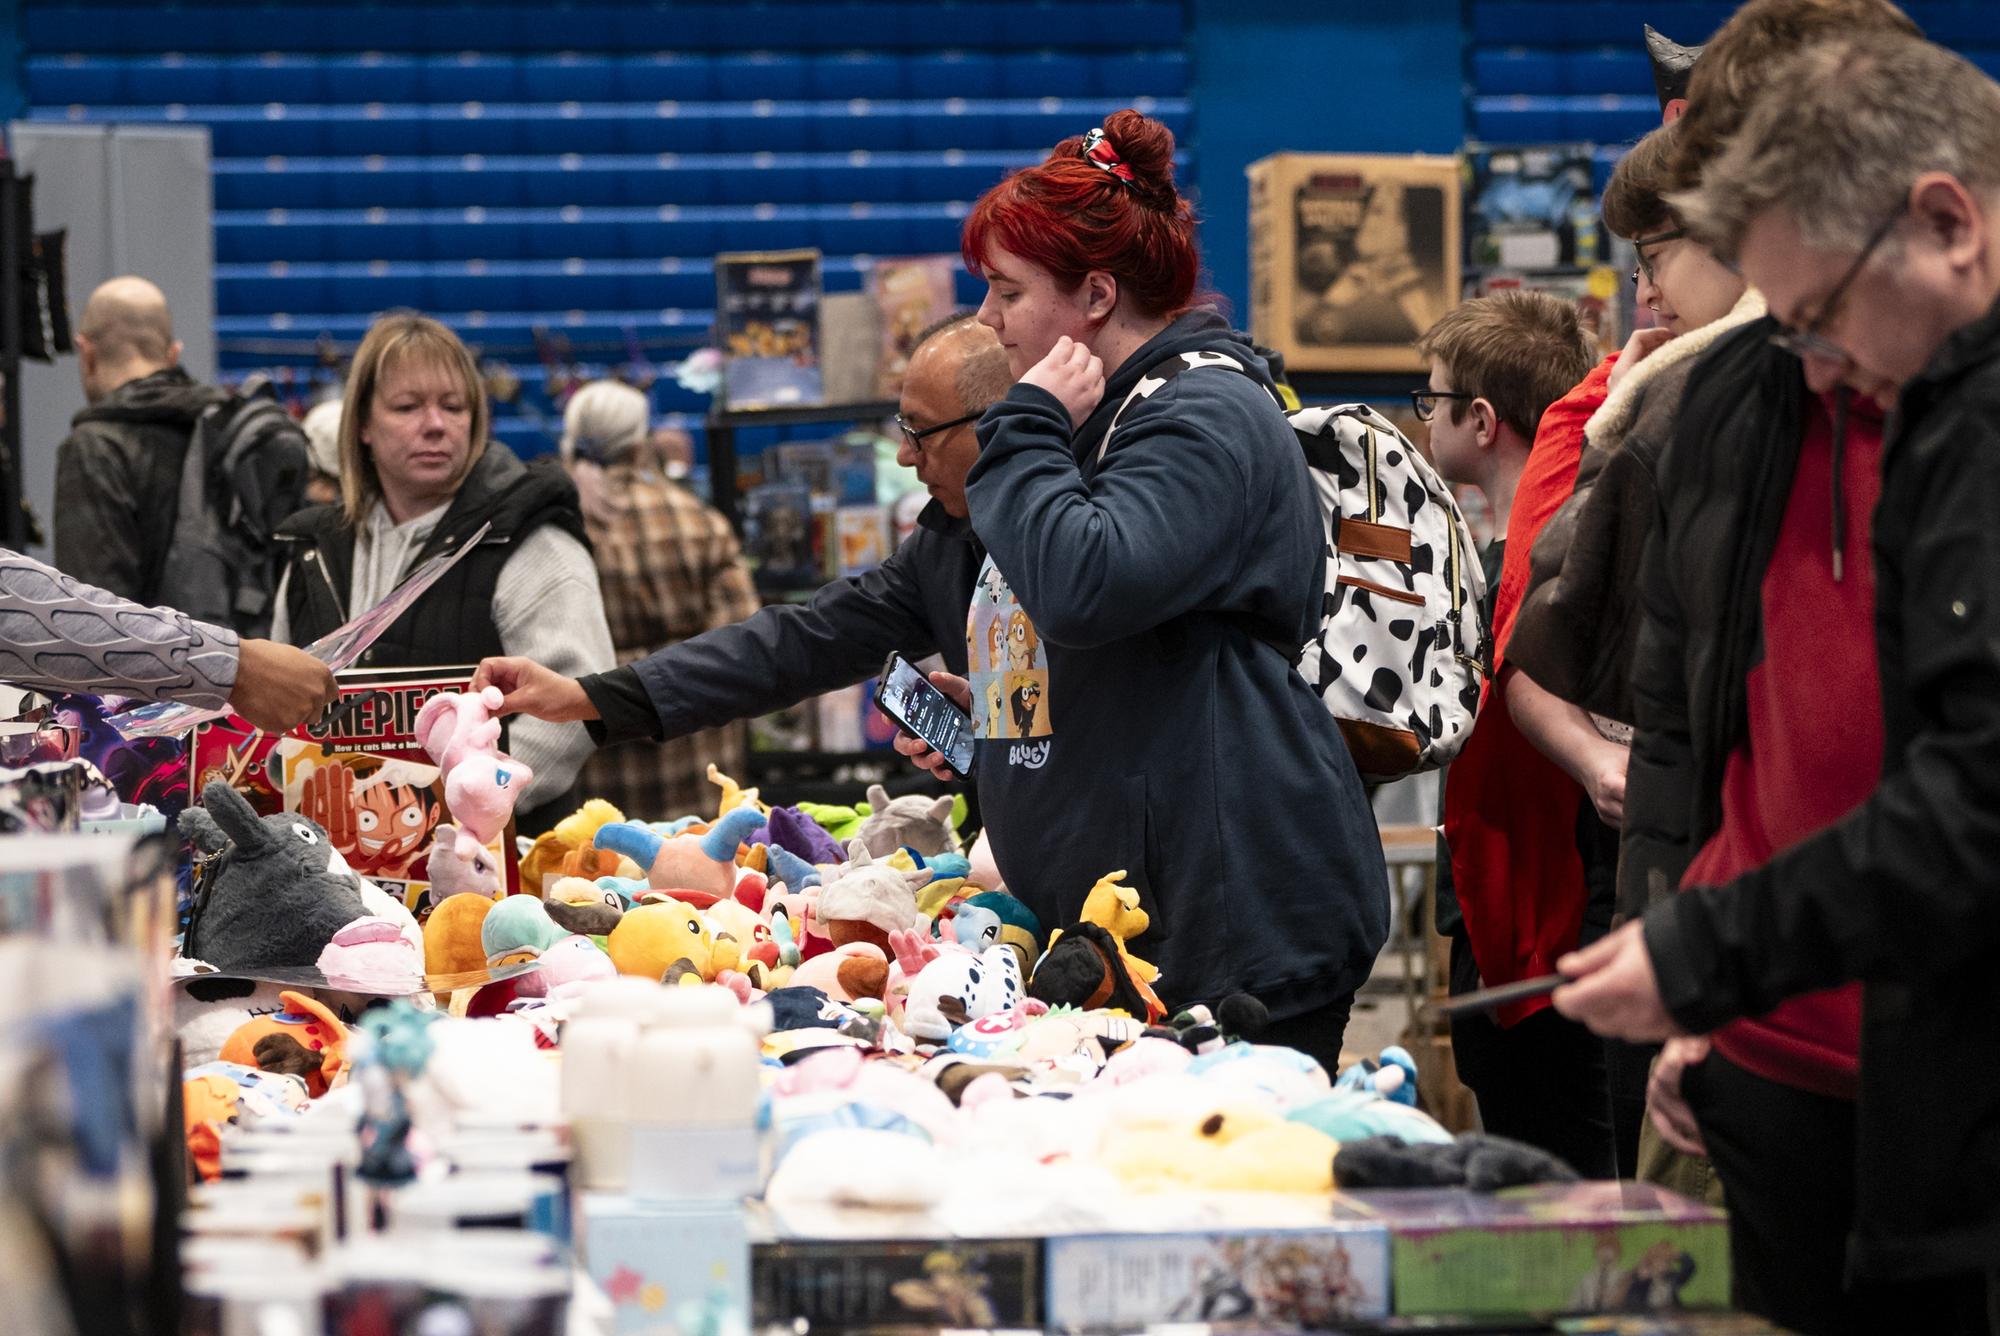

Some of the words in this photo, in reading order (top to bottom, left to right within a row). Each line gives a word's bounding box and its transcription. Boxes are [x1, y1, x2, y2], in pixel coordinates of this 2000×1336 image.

[363, 743, 380, 751] cuts
[381, 742, 397, 750] like
[406, 741, 421, 749] kni
